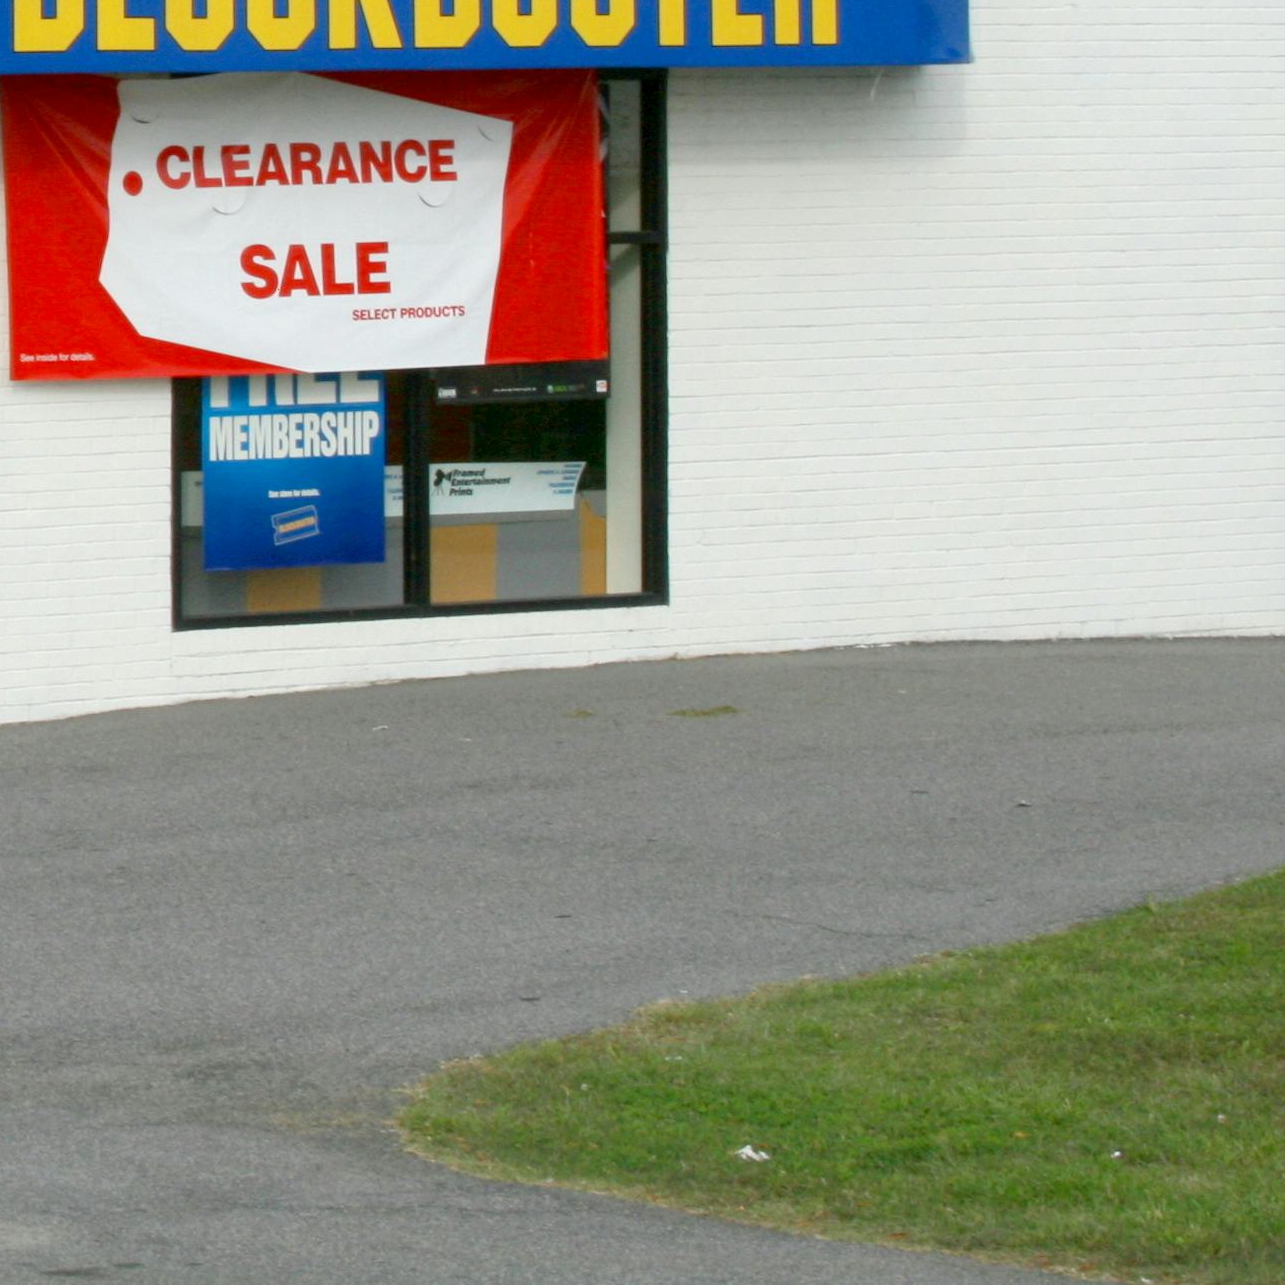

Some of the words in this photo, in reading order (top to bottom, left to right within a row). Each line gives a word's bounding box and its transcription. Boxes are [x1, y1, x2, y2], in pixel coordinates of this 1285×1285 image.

[156, 139, 458, 190] CLEARANCE
[239, 241, 391, 300] SALE
[352, 307, 396, 321] SELECT
[400, 305, 465, 319] PRODUCTS
[20, 353, 35, 363] See
[36, 352, 58, 362] inside
[59, 352, 69, 361] for
[209, 410, 380, 462] MEMBERSHIP
[452, 467, 486, 478] Framed
[451, 476, 511, 487] Entertainment
[449, 487, 473, 496] Prints
